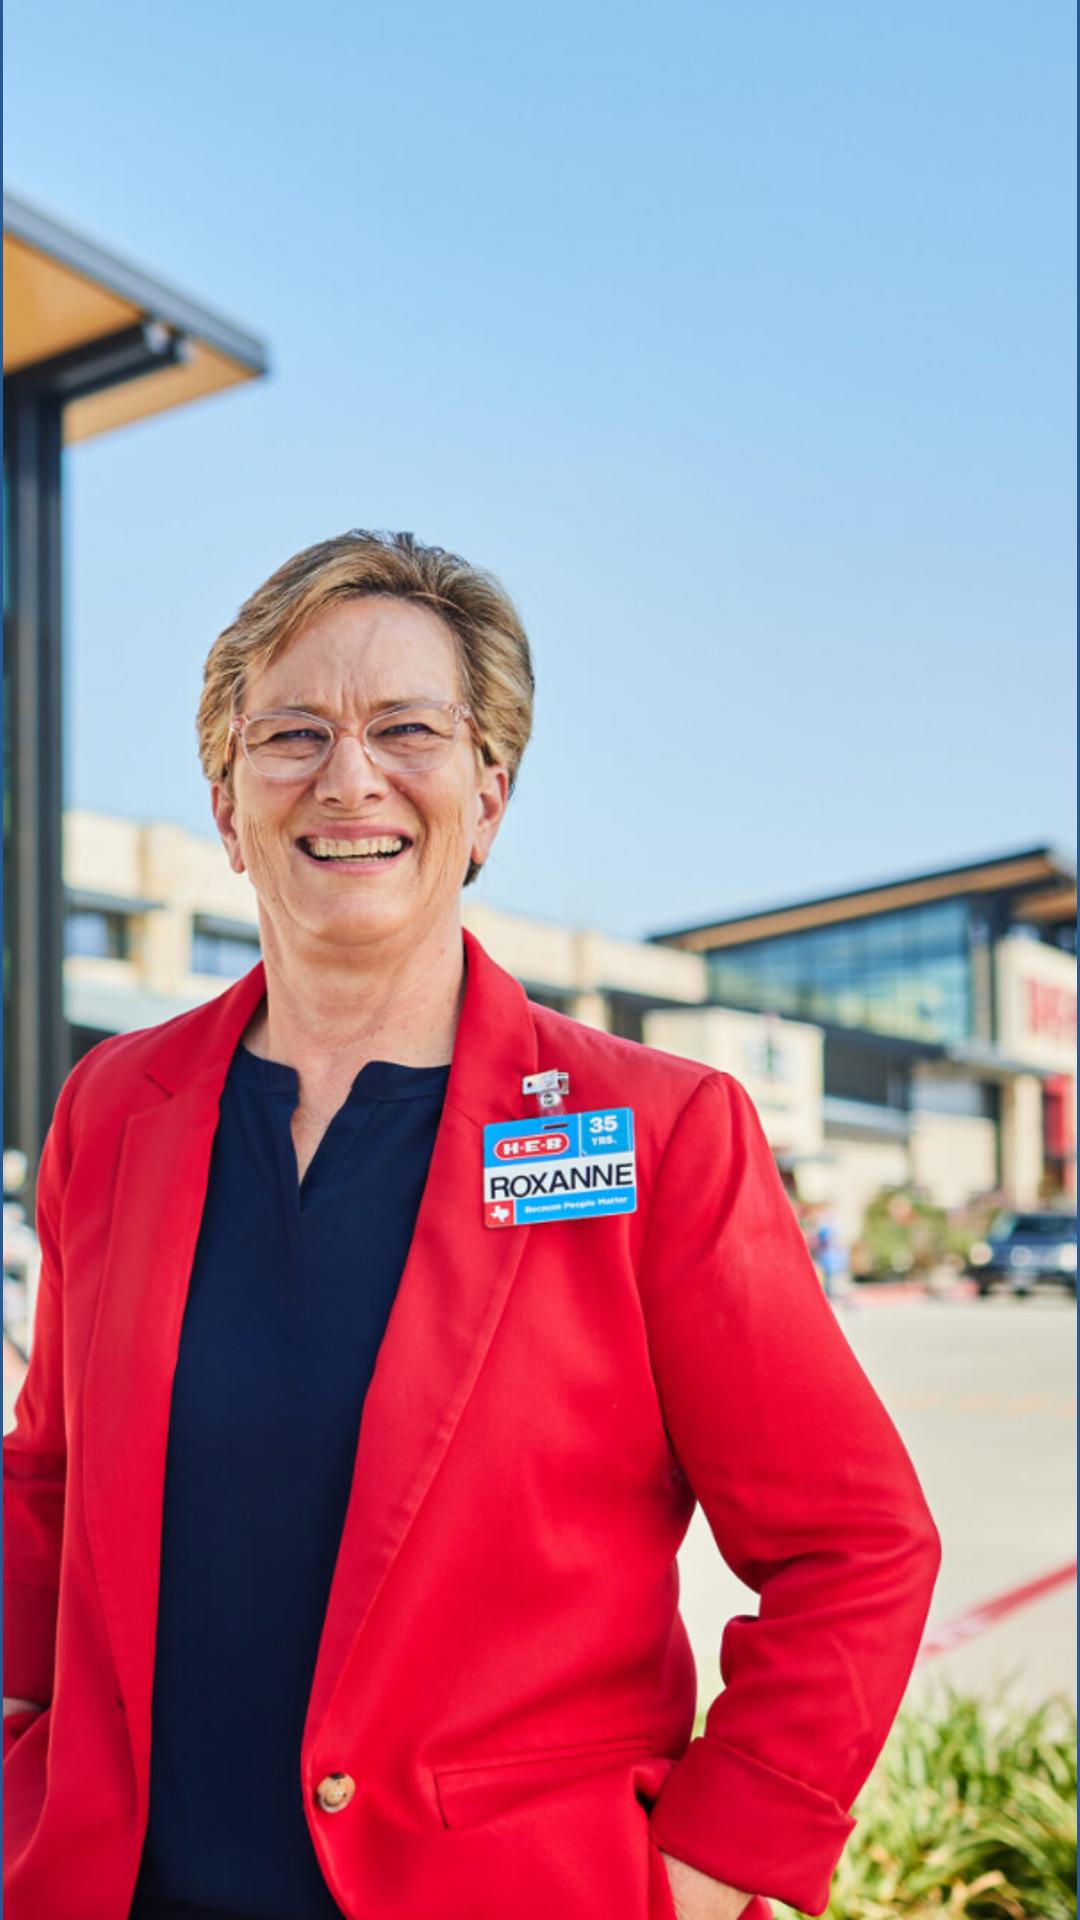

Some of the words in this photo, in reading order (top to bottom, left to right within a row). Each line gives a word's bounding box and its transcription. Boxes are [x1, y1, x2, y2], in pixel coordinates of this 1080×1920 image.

[590, 1115, 618, 1133] 35
[592, 1136, 617, 1146] YRS.
[490, 1163, 633, 1199] ROXANNE
[525, 1203, 562, 1213] Because
[564, 1199, 595, 1209] People
[598, 1196, 628, 1205] Matter
